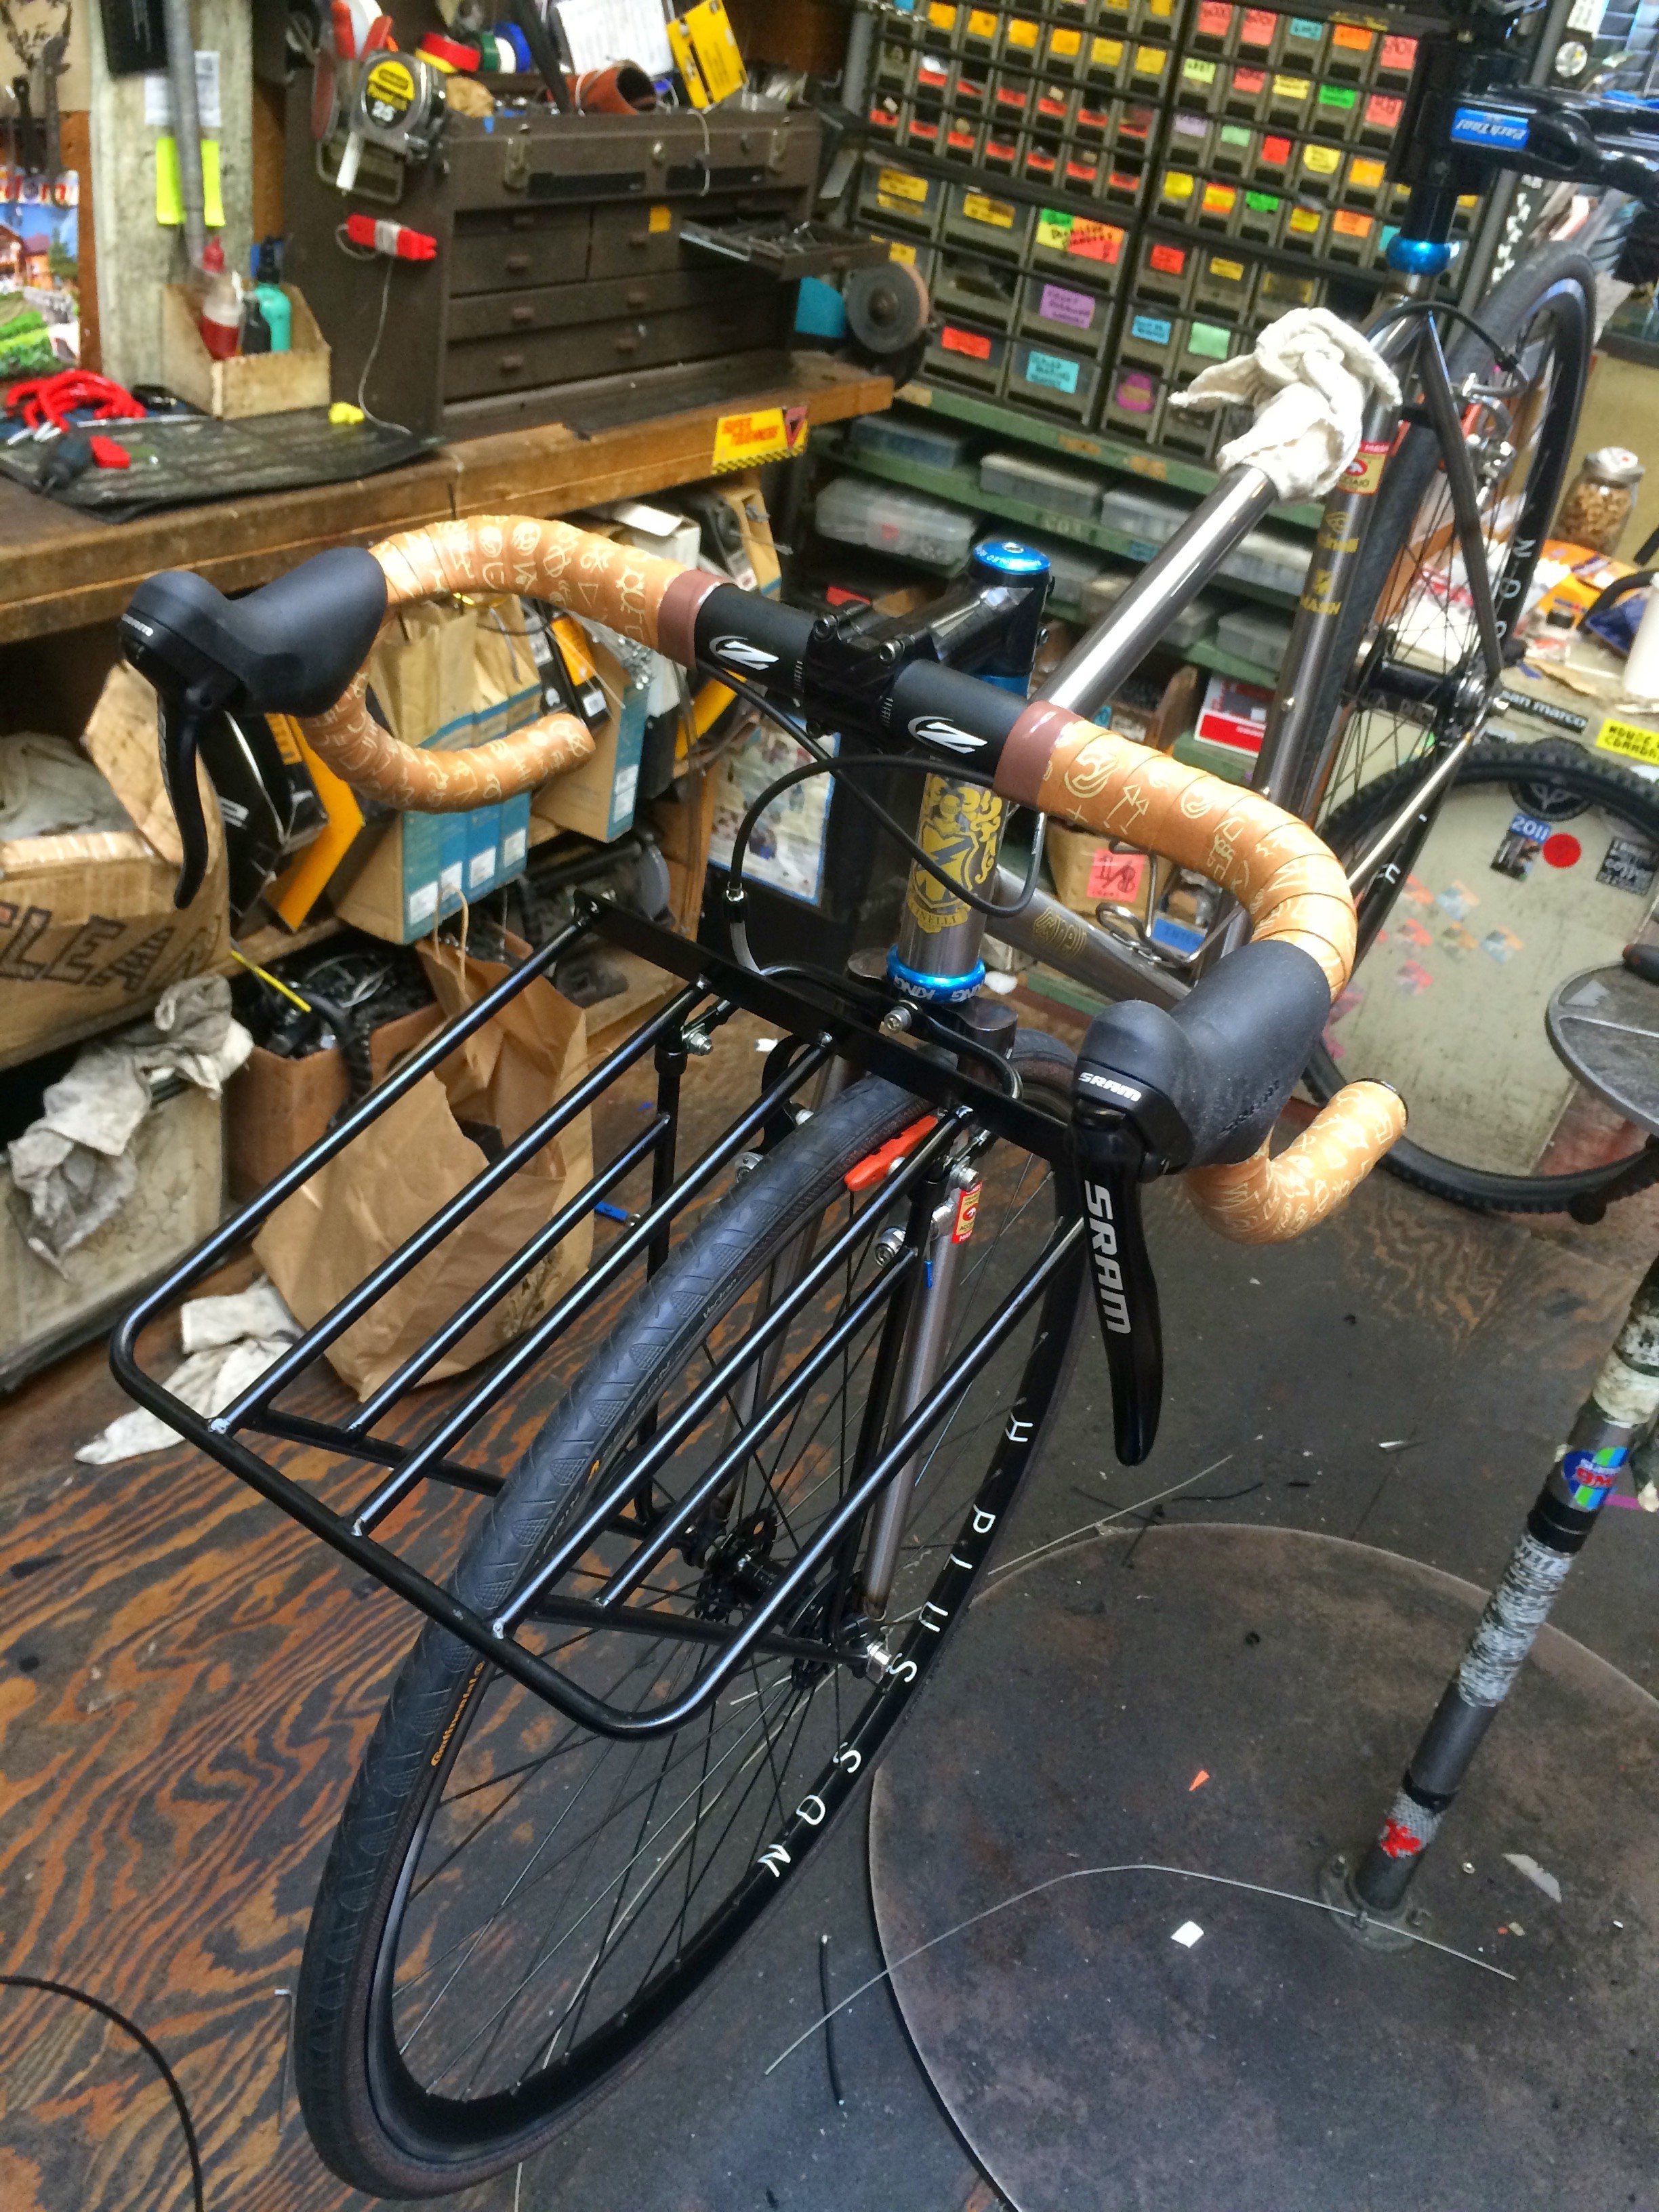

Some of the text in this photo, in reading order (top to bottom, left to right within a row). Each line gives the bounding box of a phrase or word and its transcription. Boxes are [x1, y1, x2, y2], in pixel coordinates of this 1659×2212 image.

[1511, 815, 1551, 841] 2011
[893, 974, 936, 1001] KING
[949, 979, 985, 1003] ING
[1079, 1071, 1142, 1103] SRAM
[1084, 1179, 1132, 1334] SRAM
